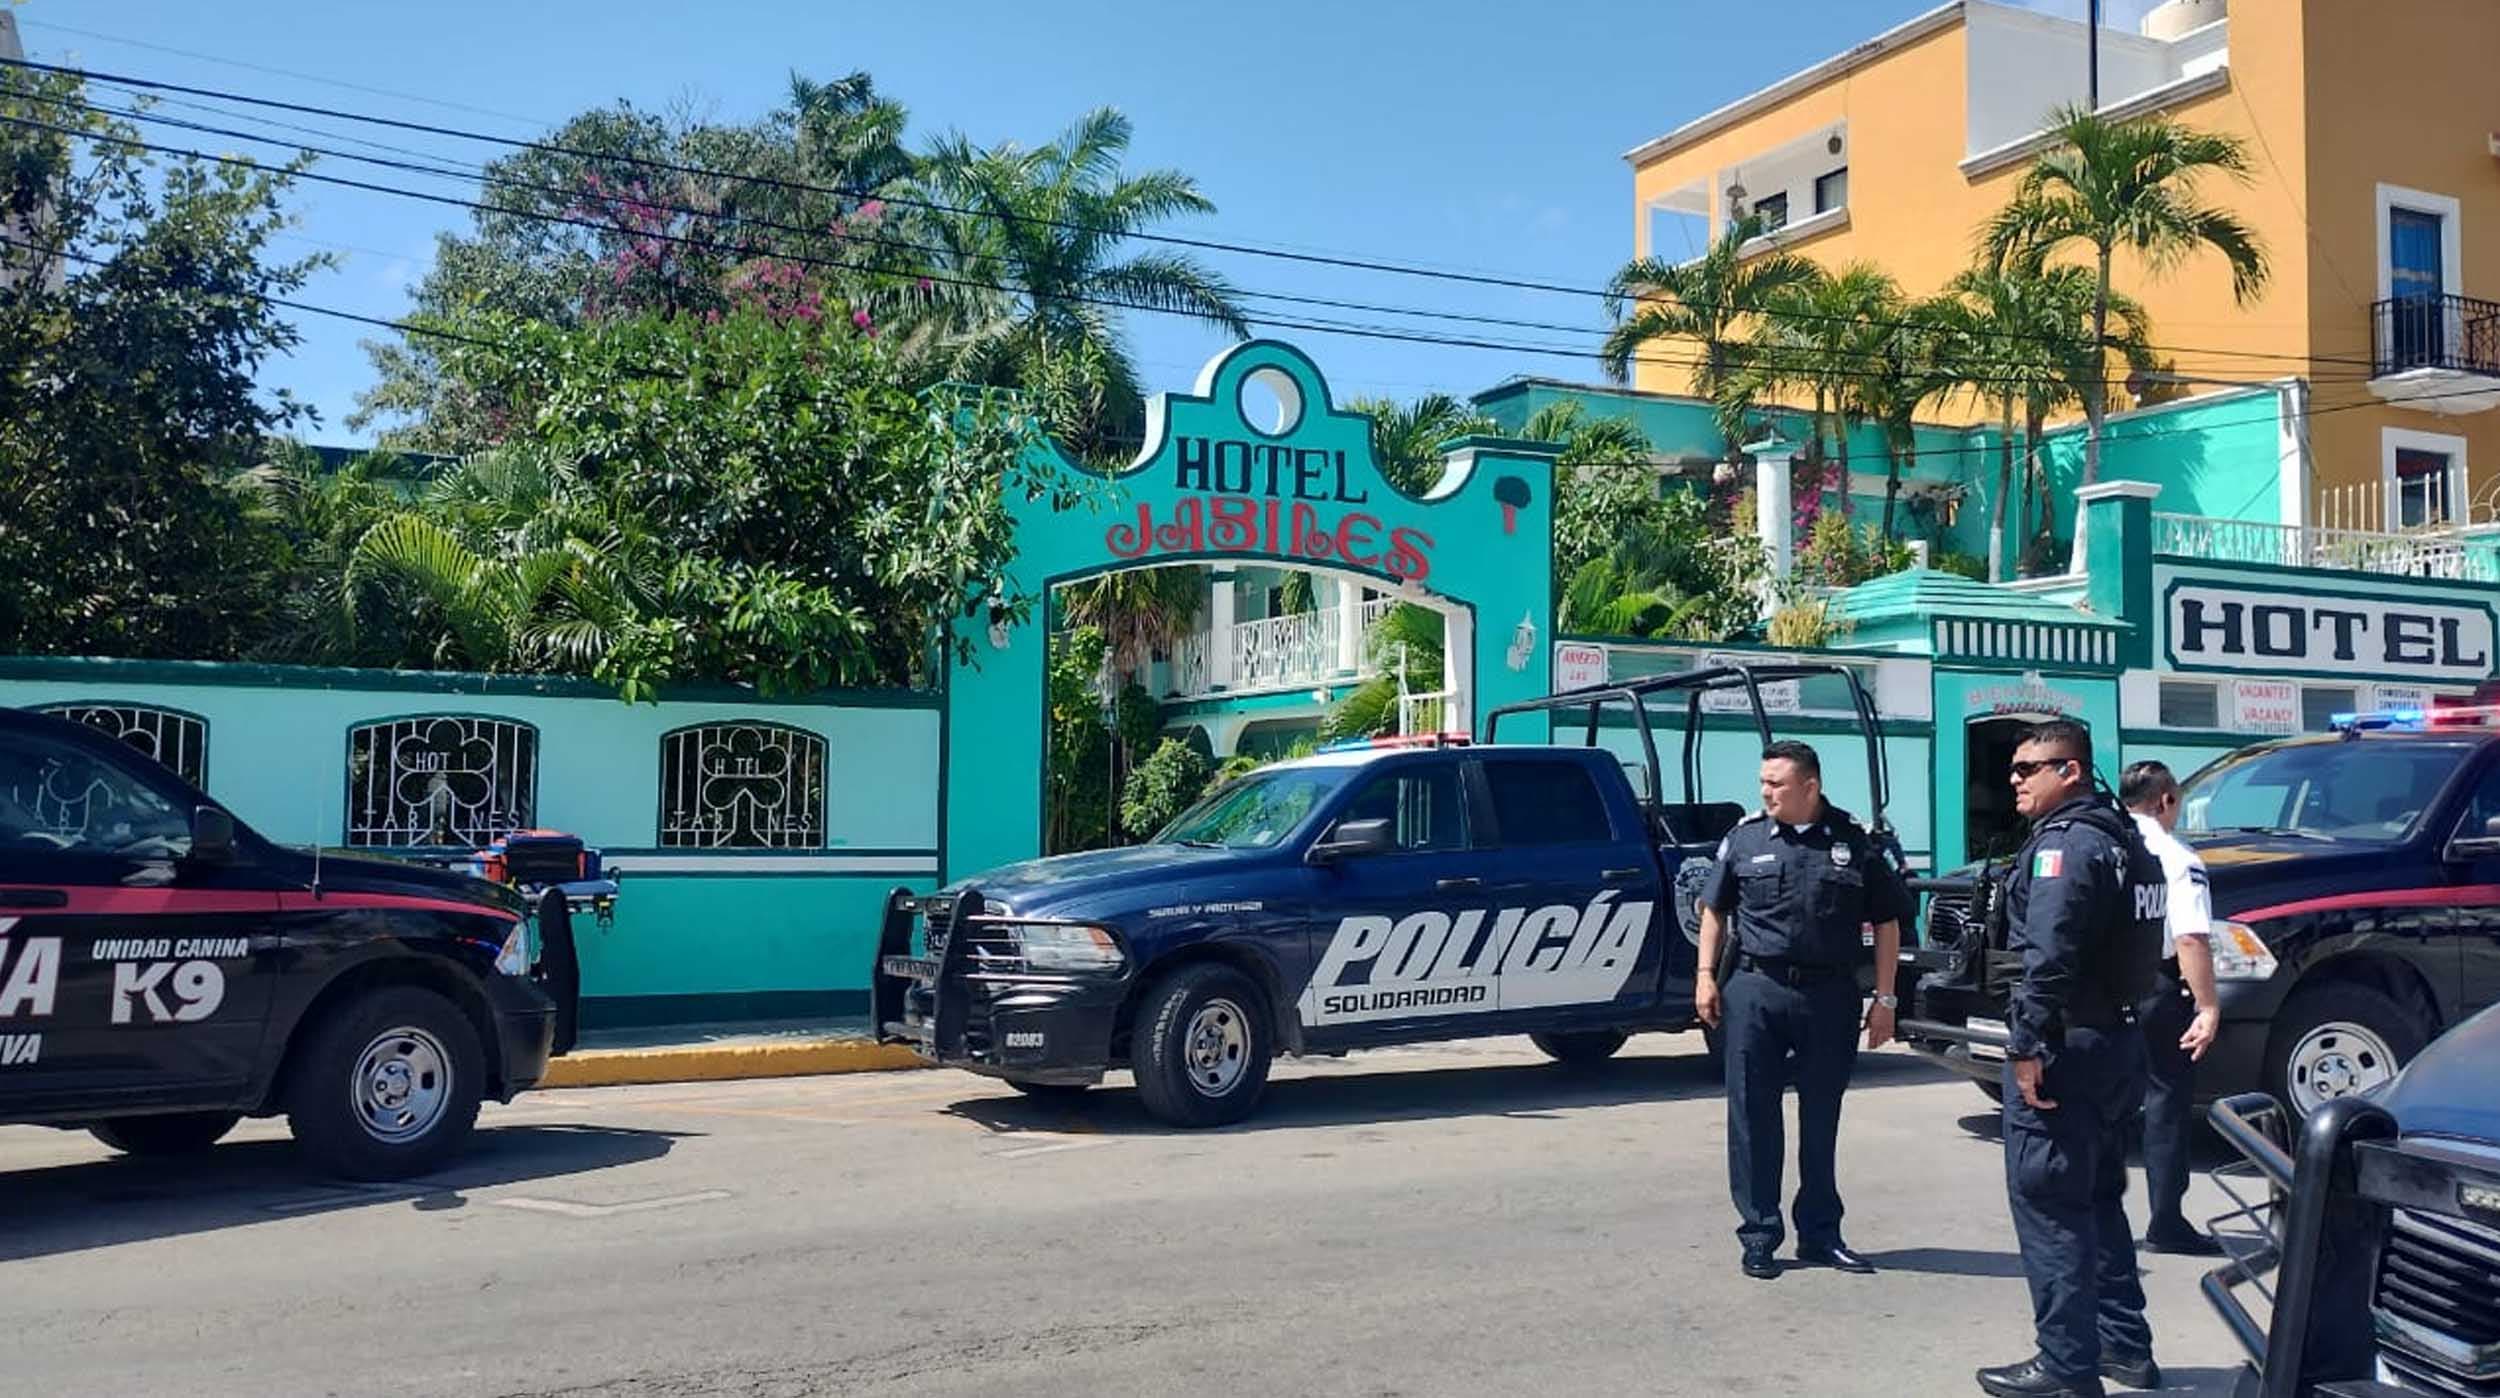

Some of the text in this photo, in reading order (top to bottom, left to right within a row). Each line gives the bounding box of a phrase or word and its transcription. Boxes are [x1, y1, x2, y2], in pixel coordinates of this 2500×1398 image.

[1174, 436, 1368, 503] HOTEL
[2181, 599, 2485, 667] HOTEL
[1191, 904, 1202, 914] Y
[2134, 884, 2168, 919] POLI
[92, 938, 249, 959] UNIDAD CANINA
[1312, 889, 1654, 987] POLICÍA
[111, 960, 225, 1024] K9
[1324, 985, 1486, 1015] SOLIDARIDAD
